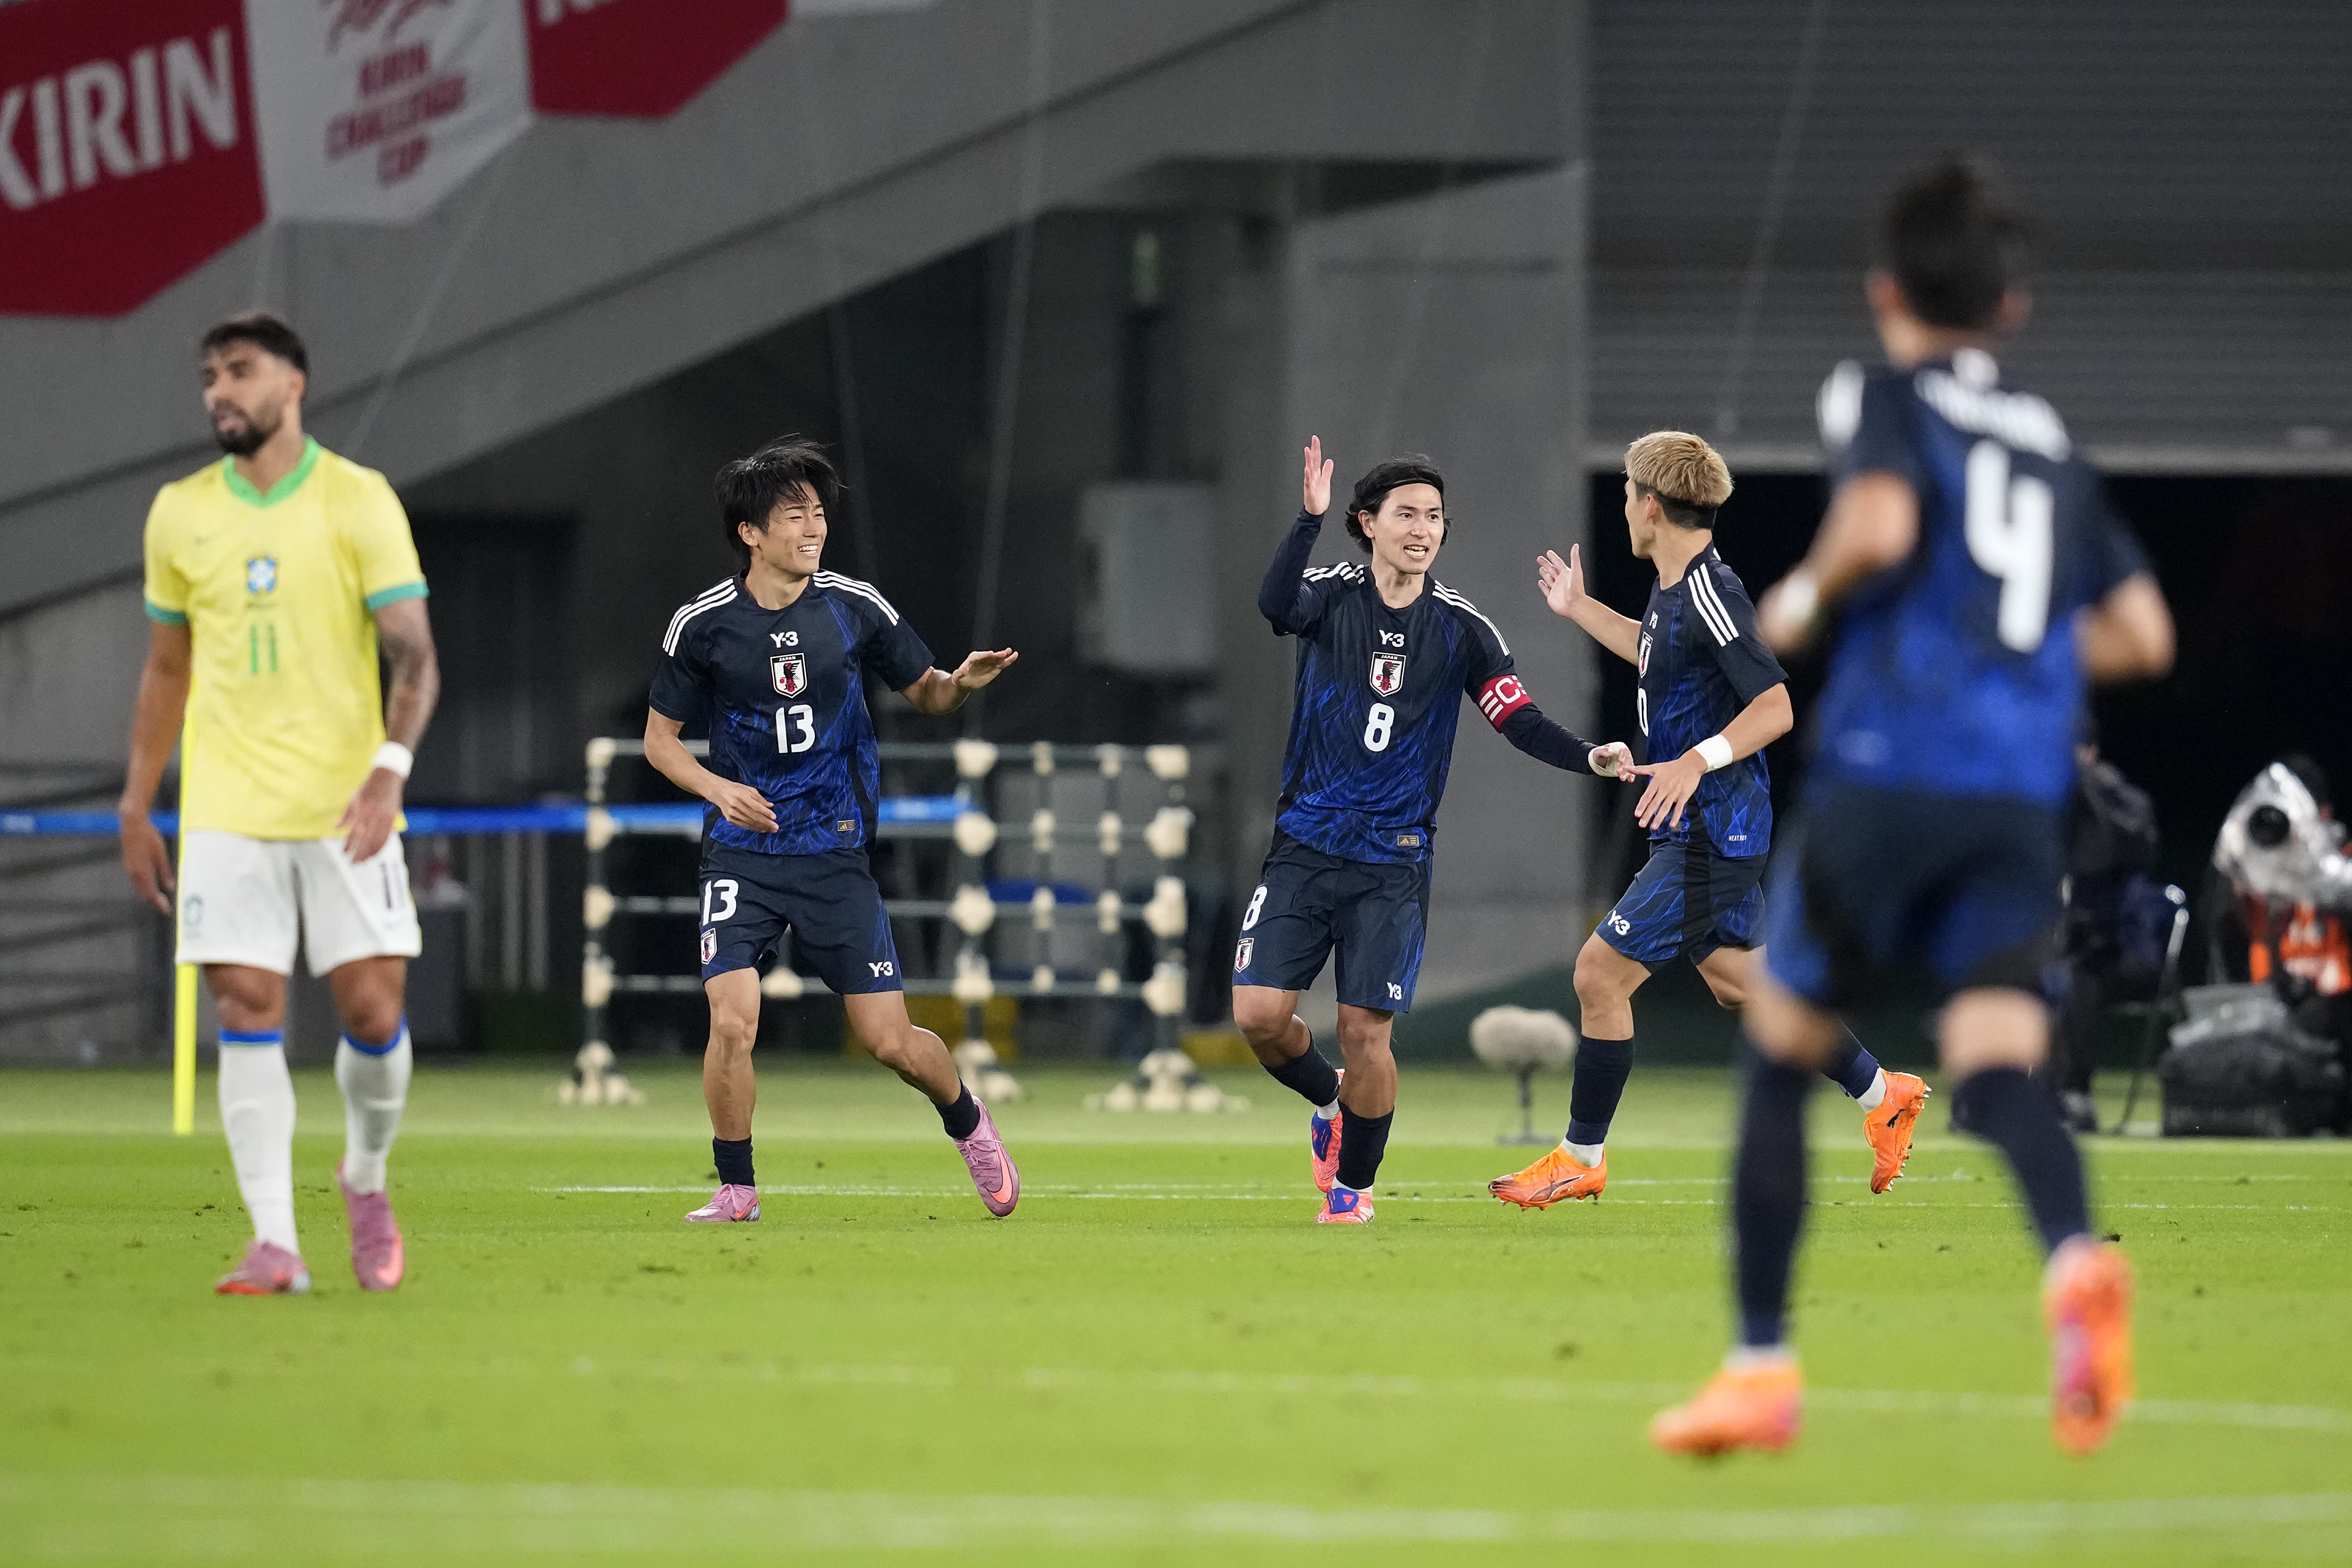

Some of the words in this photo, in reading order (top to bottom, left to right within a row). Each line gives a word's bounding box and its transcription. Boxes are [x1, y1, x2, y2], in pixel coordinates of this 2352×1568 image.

[1965, 439, 2054, 652] 4
[250, 624, 278, 673] 11
[770, 631, 799, 648] Y-3
[1379, 629, 1405, 647] Y-3
[776, 704, 815, 754] 13
[1363, 702, 1395, 752] 8
[702, 879, 739, 926] 13
[1242, 886, 1268, 931] 8
[1607, 910, 1631, 936] Y-3
[869, 961, 893, 978] Y-3
[1387, 982, 1402, 1000] Y-3
